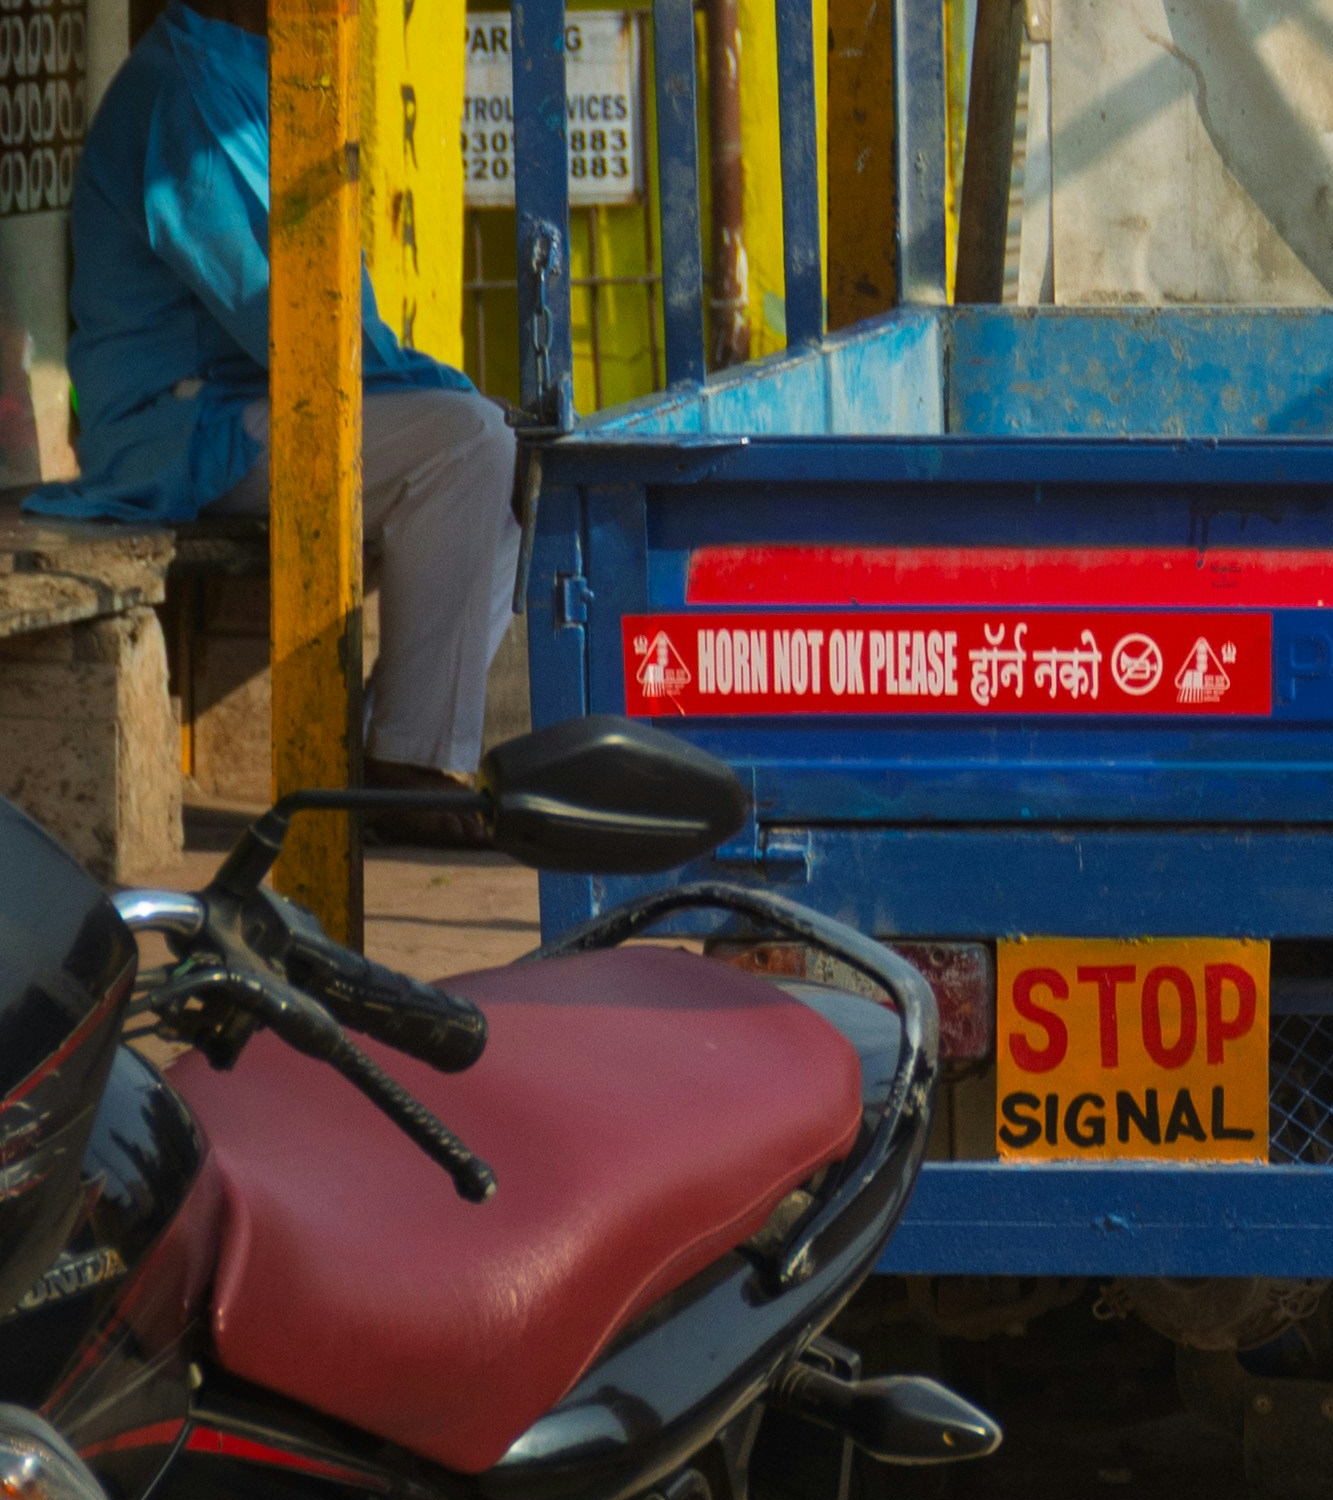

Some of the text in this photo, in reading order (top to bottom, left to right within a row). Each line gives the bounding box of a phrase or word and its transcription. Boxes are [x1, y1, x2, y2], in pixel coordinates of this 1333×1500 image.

[698, 629, 768, 695] HORN
[773, 629, 825, 695] NOT
[828, 629, 868, 695] OK
[869, 629, 958, 696] PLEASE
[968, 622, 1103, 707] हॉर्न नको
[1008, 962, 1258, 1074] STOP
[998, 1085, 1256, 1149] SIGNAL
